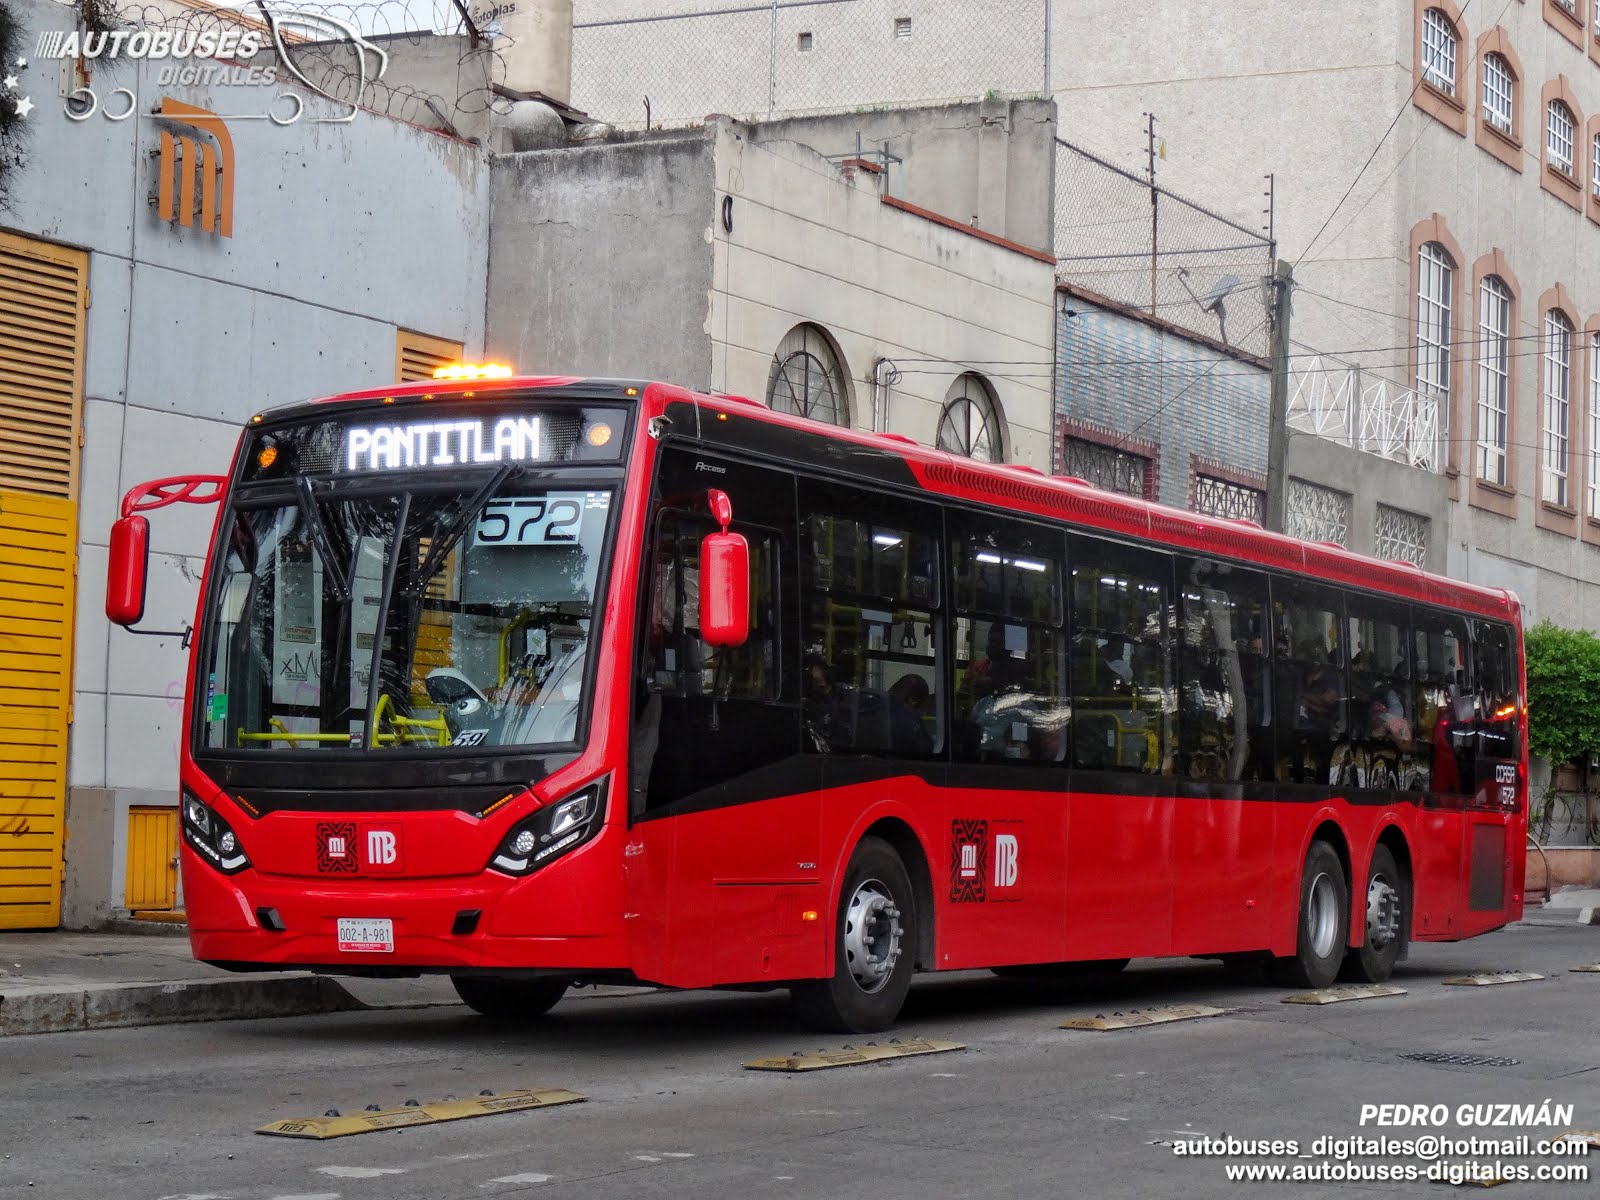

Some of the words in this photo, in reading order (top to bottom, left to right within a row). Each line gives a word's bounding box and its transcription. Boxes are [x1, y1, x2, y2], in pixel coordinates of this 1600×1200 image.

[473, 3, 516, 26] Rotoplas
[347, 417, 541, 470] PANTITLAN
[694, 461, 727, 474] Access
[477, 500, 582, 542] 572
[1502, 786, 1515, 805] 572
[339, 927, 391, 942] 002-A-981
